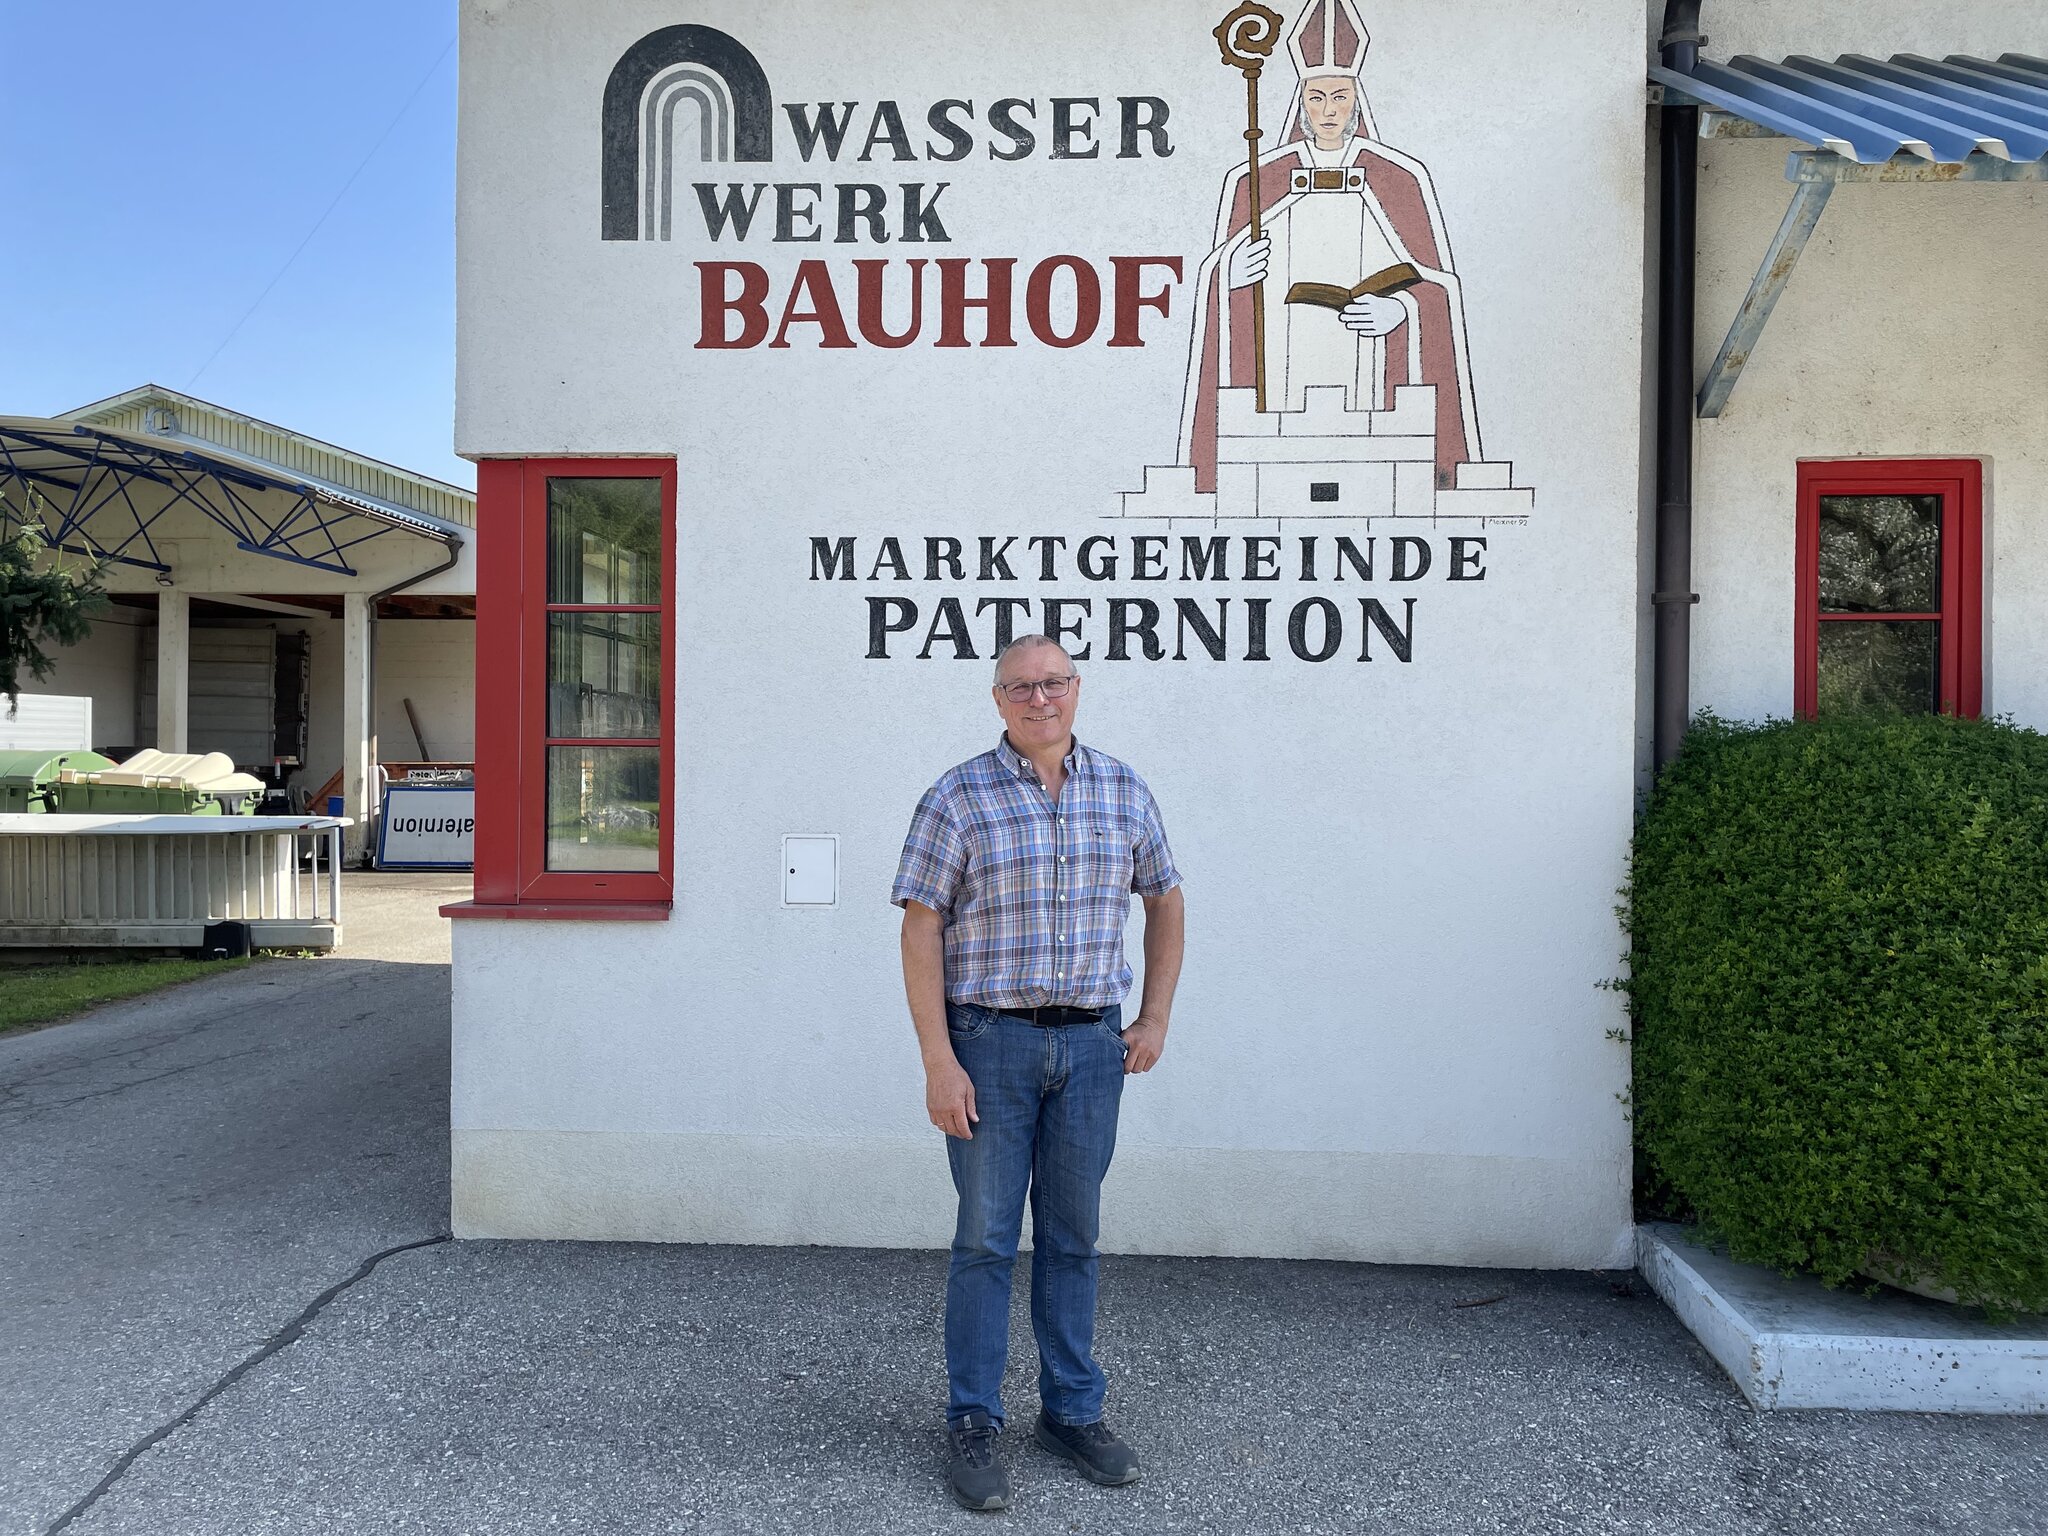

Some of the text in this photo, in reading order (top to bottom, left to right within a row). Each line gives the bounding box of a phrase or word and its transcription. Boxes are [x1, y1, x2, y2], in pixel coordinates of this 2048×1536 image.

[782, 97, 1175, 162] WASSER
[692, 183, 951, 243] WERK
[693, 255, 1183, 349] BAUHOF
[809, 536, 1487, 581] MARKTGEMEINDE
[865, 597, 1417, 662] PATERNION
[394, 818, 474, 838] aternion
